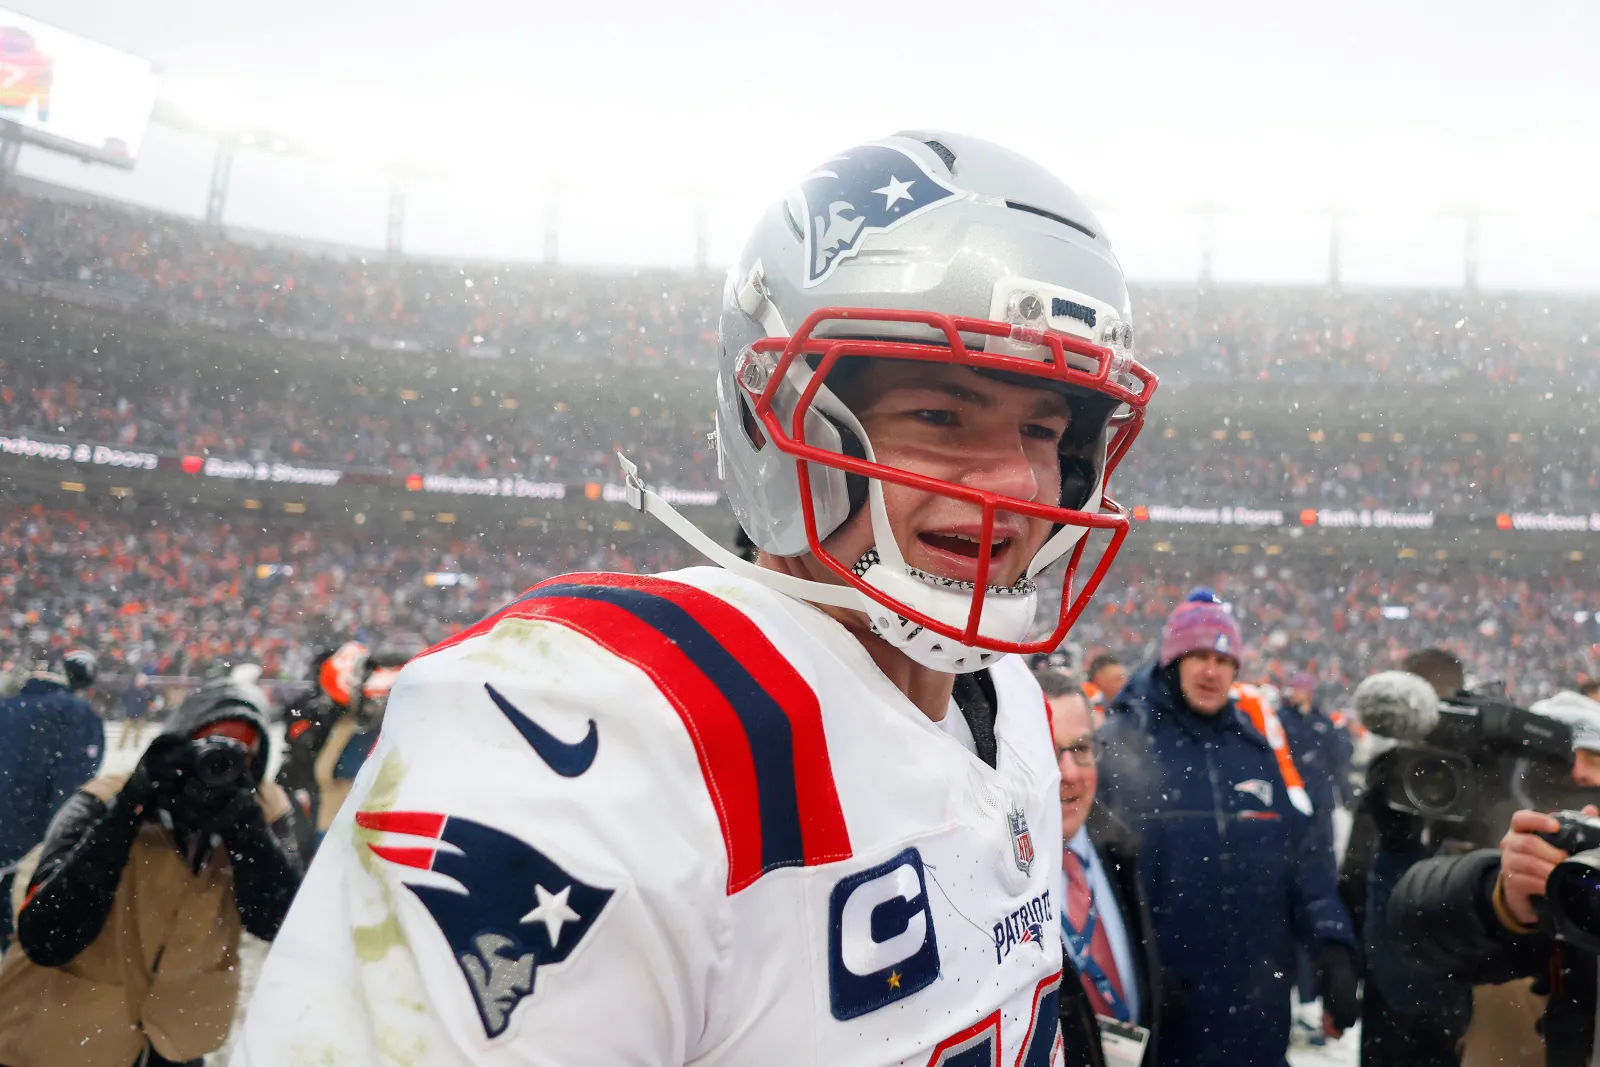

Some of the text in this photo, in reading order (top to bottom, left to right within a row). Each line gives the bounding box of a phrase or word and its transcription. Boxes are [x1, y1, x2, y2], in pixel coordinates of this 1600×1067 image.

[1052, 298, 1096, 328] PATRIOTS
[93, 445, 158, 470] Doors
[842, 863, 927, 977] C
